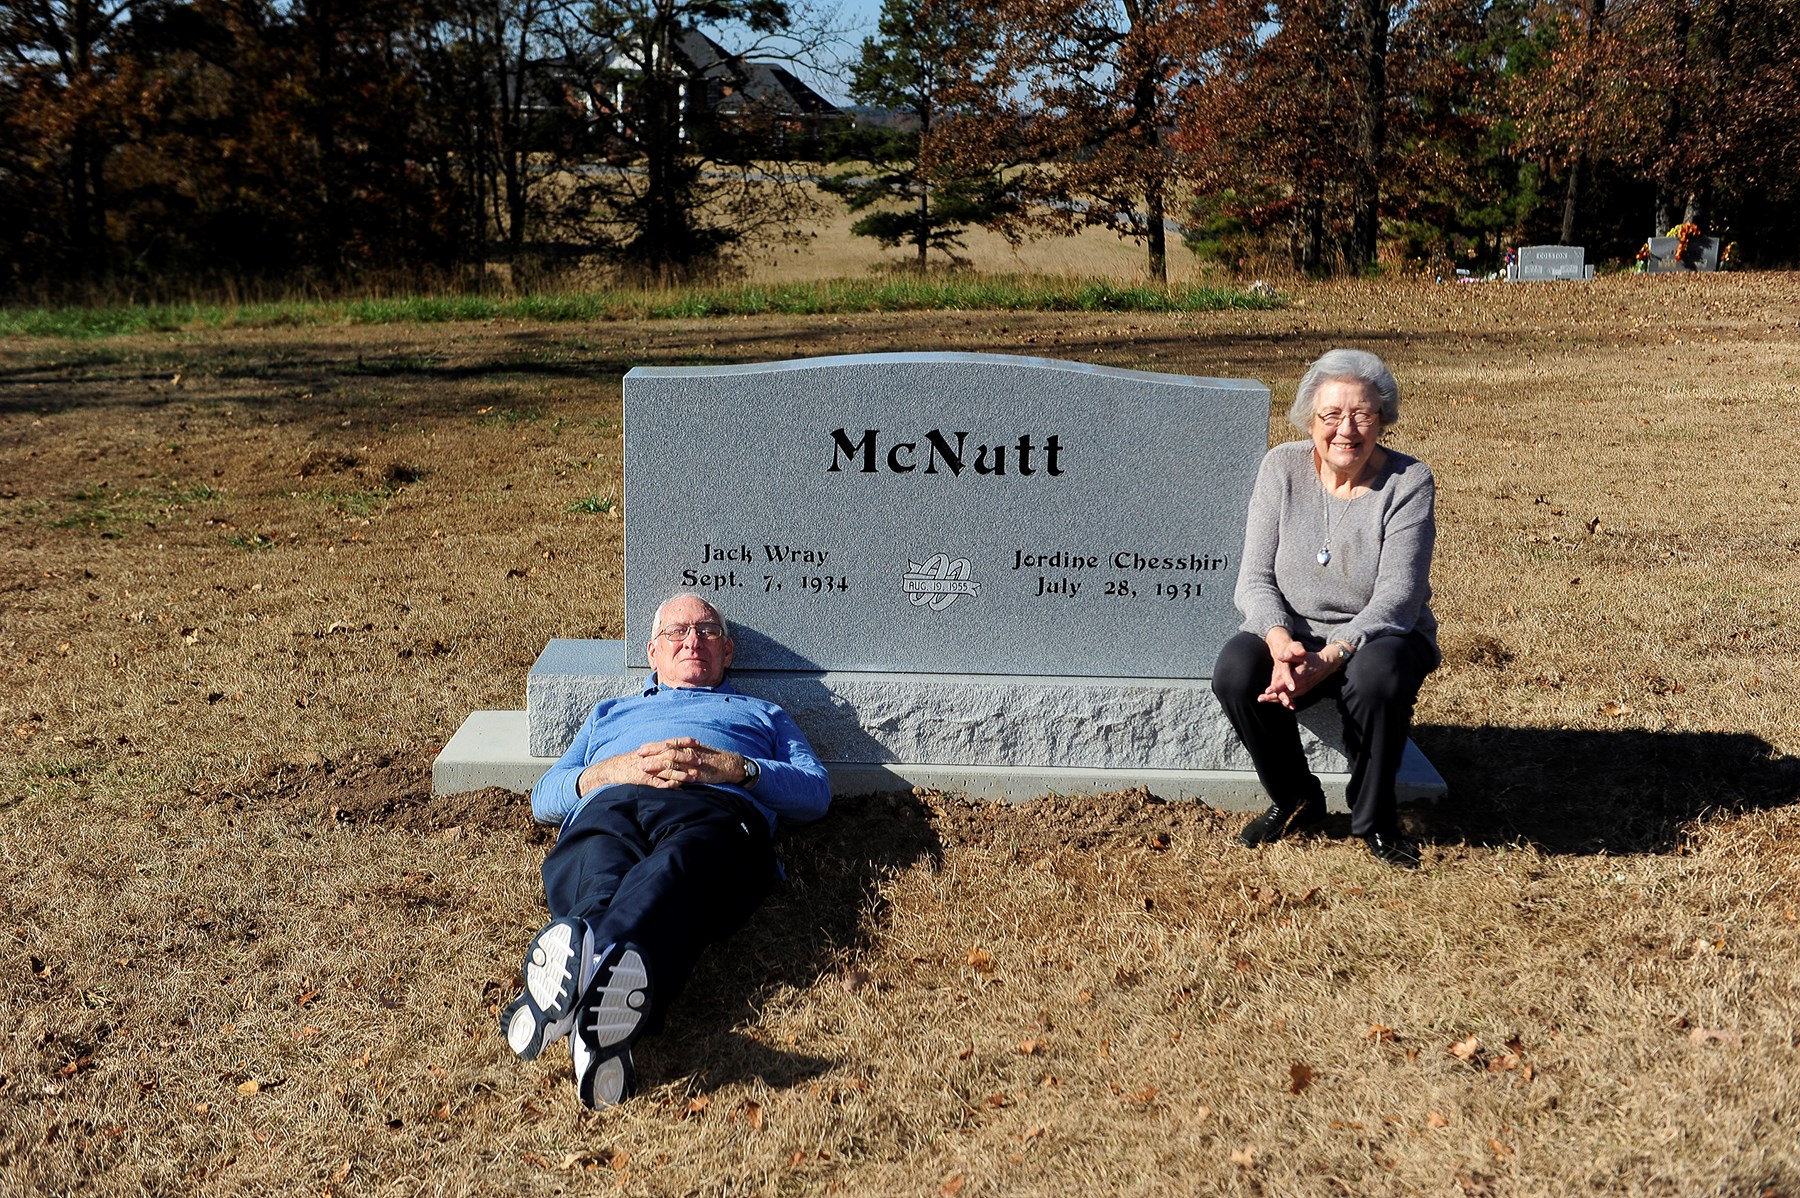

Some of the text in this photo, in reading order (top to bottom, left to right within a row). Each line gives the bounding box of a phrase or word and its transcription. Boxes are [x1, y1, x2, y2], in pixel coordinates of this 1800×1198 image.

[827, 428, 1065, 478] McNutt
[701, 543, 829, 567] Jack Wray
[1012, 550, 1229, 574] Jordine (Chesshir)
[681, 569, 849, 594] Sept. 7, 1934
[949, 582, 968, 592] 1955
[1035, 576, 1202, 601] July 28, 1931
